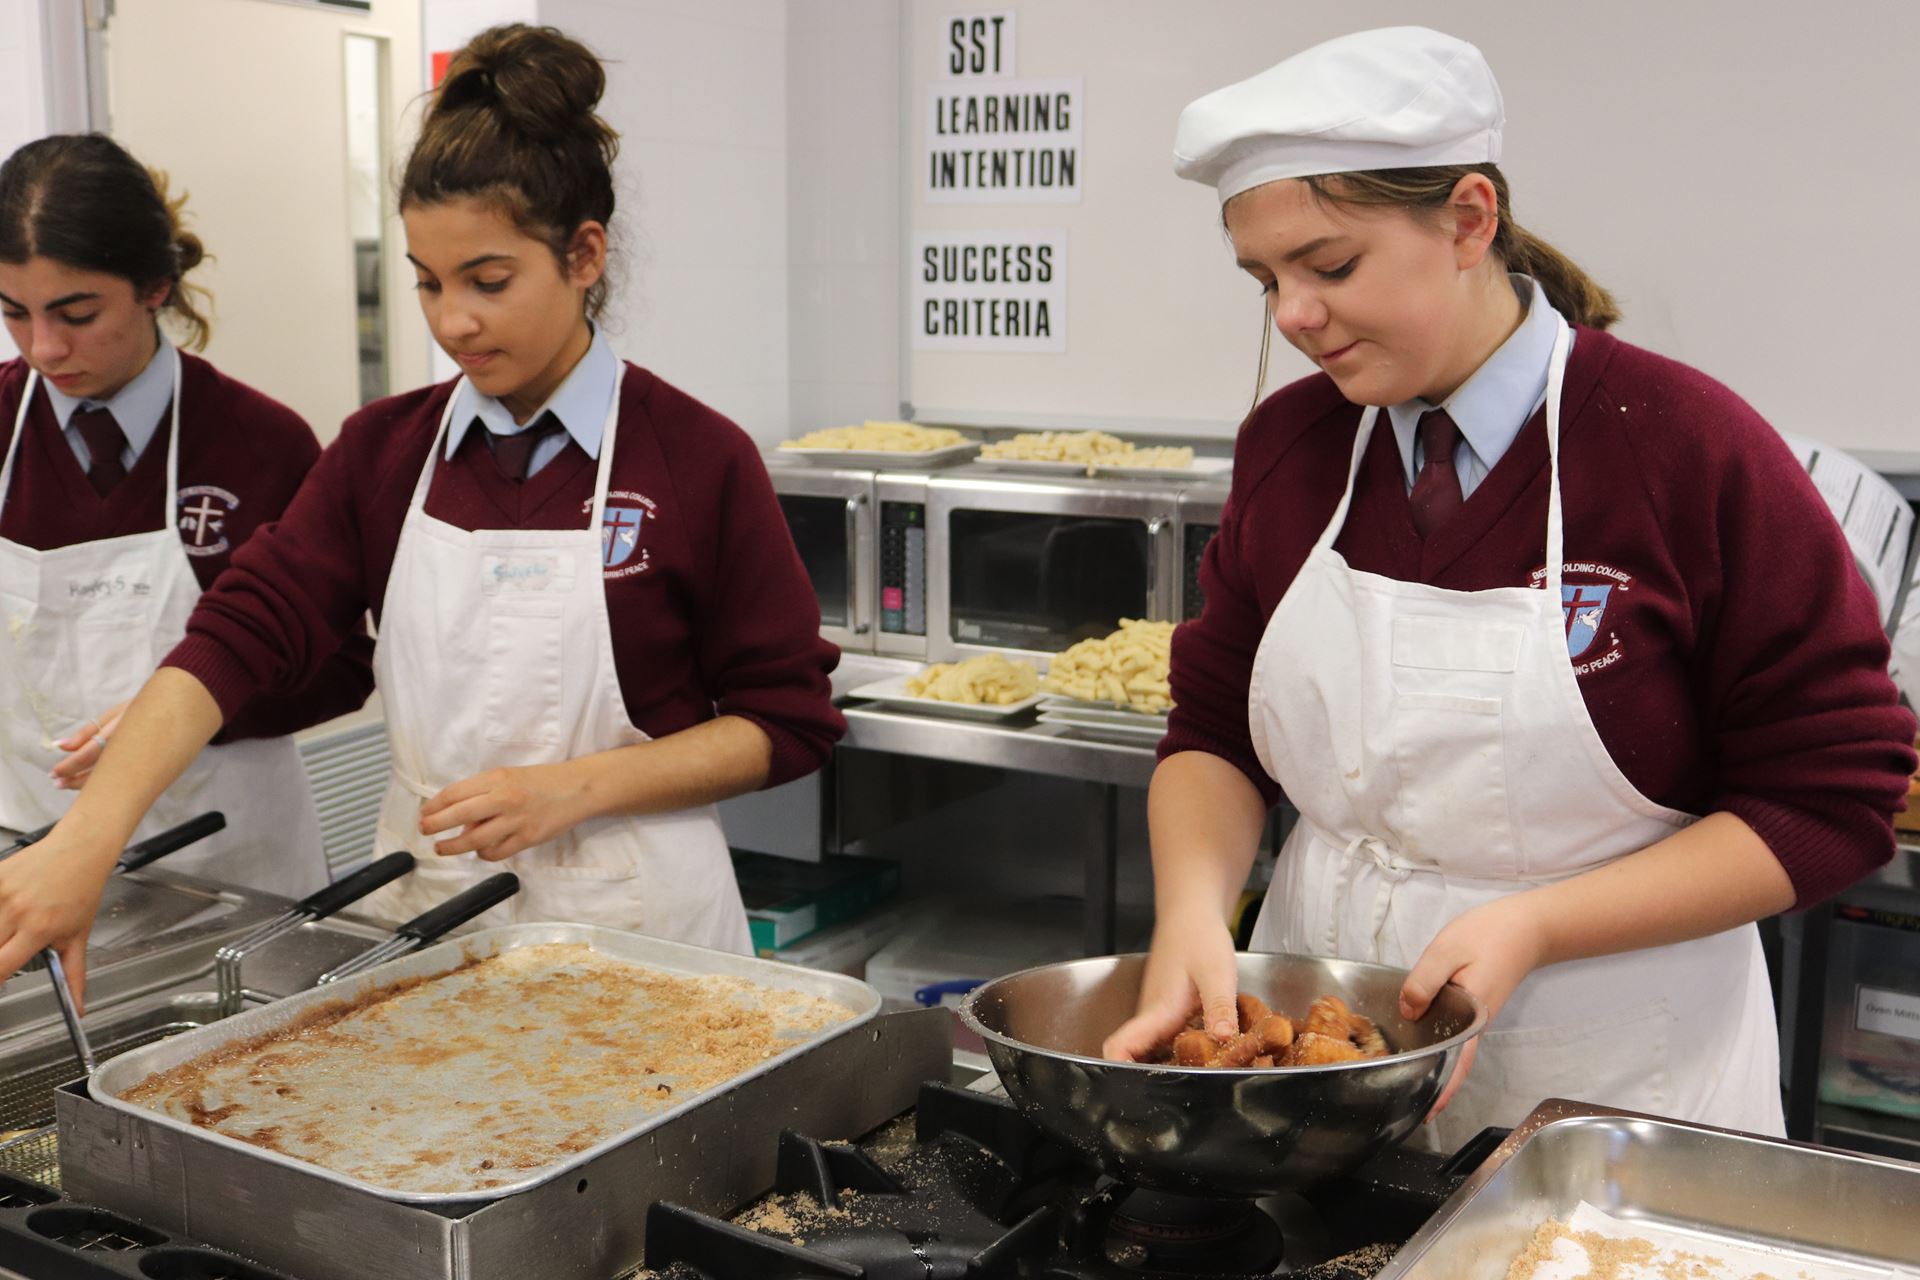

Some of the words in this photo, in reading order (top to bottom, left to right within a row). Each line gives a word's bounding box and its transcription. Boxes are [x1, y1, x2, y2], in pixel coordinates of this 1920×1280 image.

[949, 16, 1005, 74] SST
[936, 93, 1070, 134] LEARNING
[930, 148, 1076, 188] INTENTION
[923, 244, 1053, 282] SUCCESS
[923, 299, 1051, 337] CRITERIA
[1563, 563, 1595, 572] OLDING
[1595, 565, 1632, 583] COLLEGE
[1589, 649, 1622, 672] PEACE
